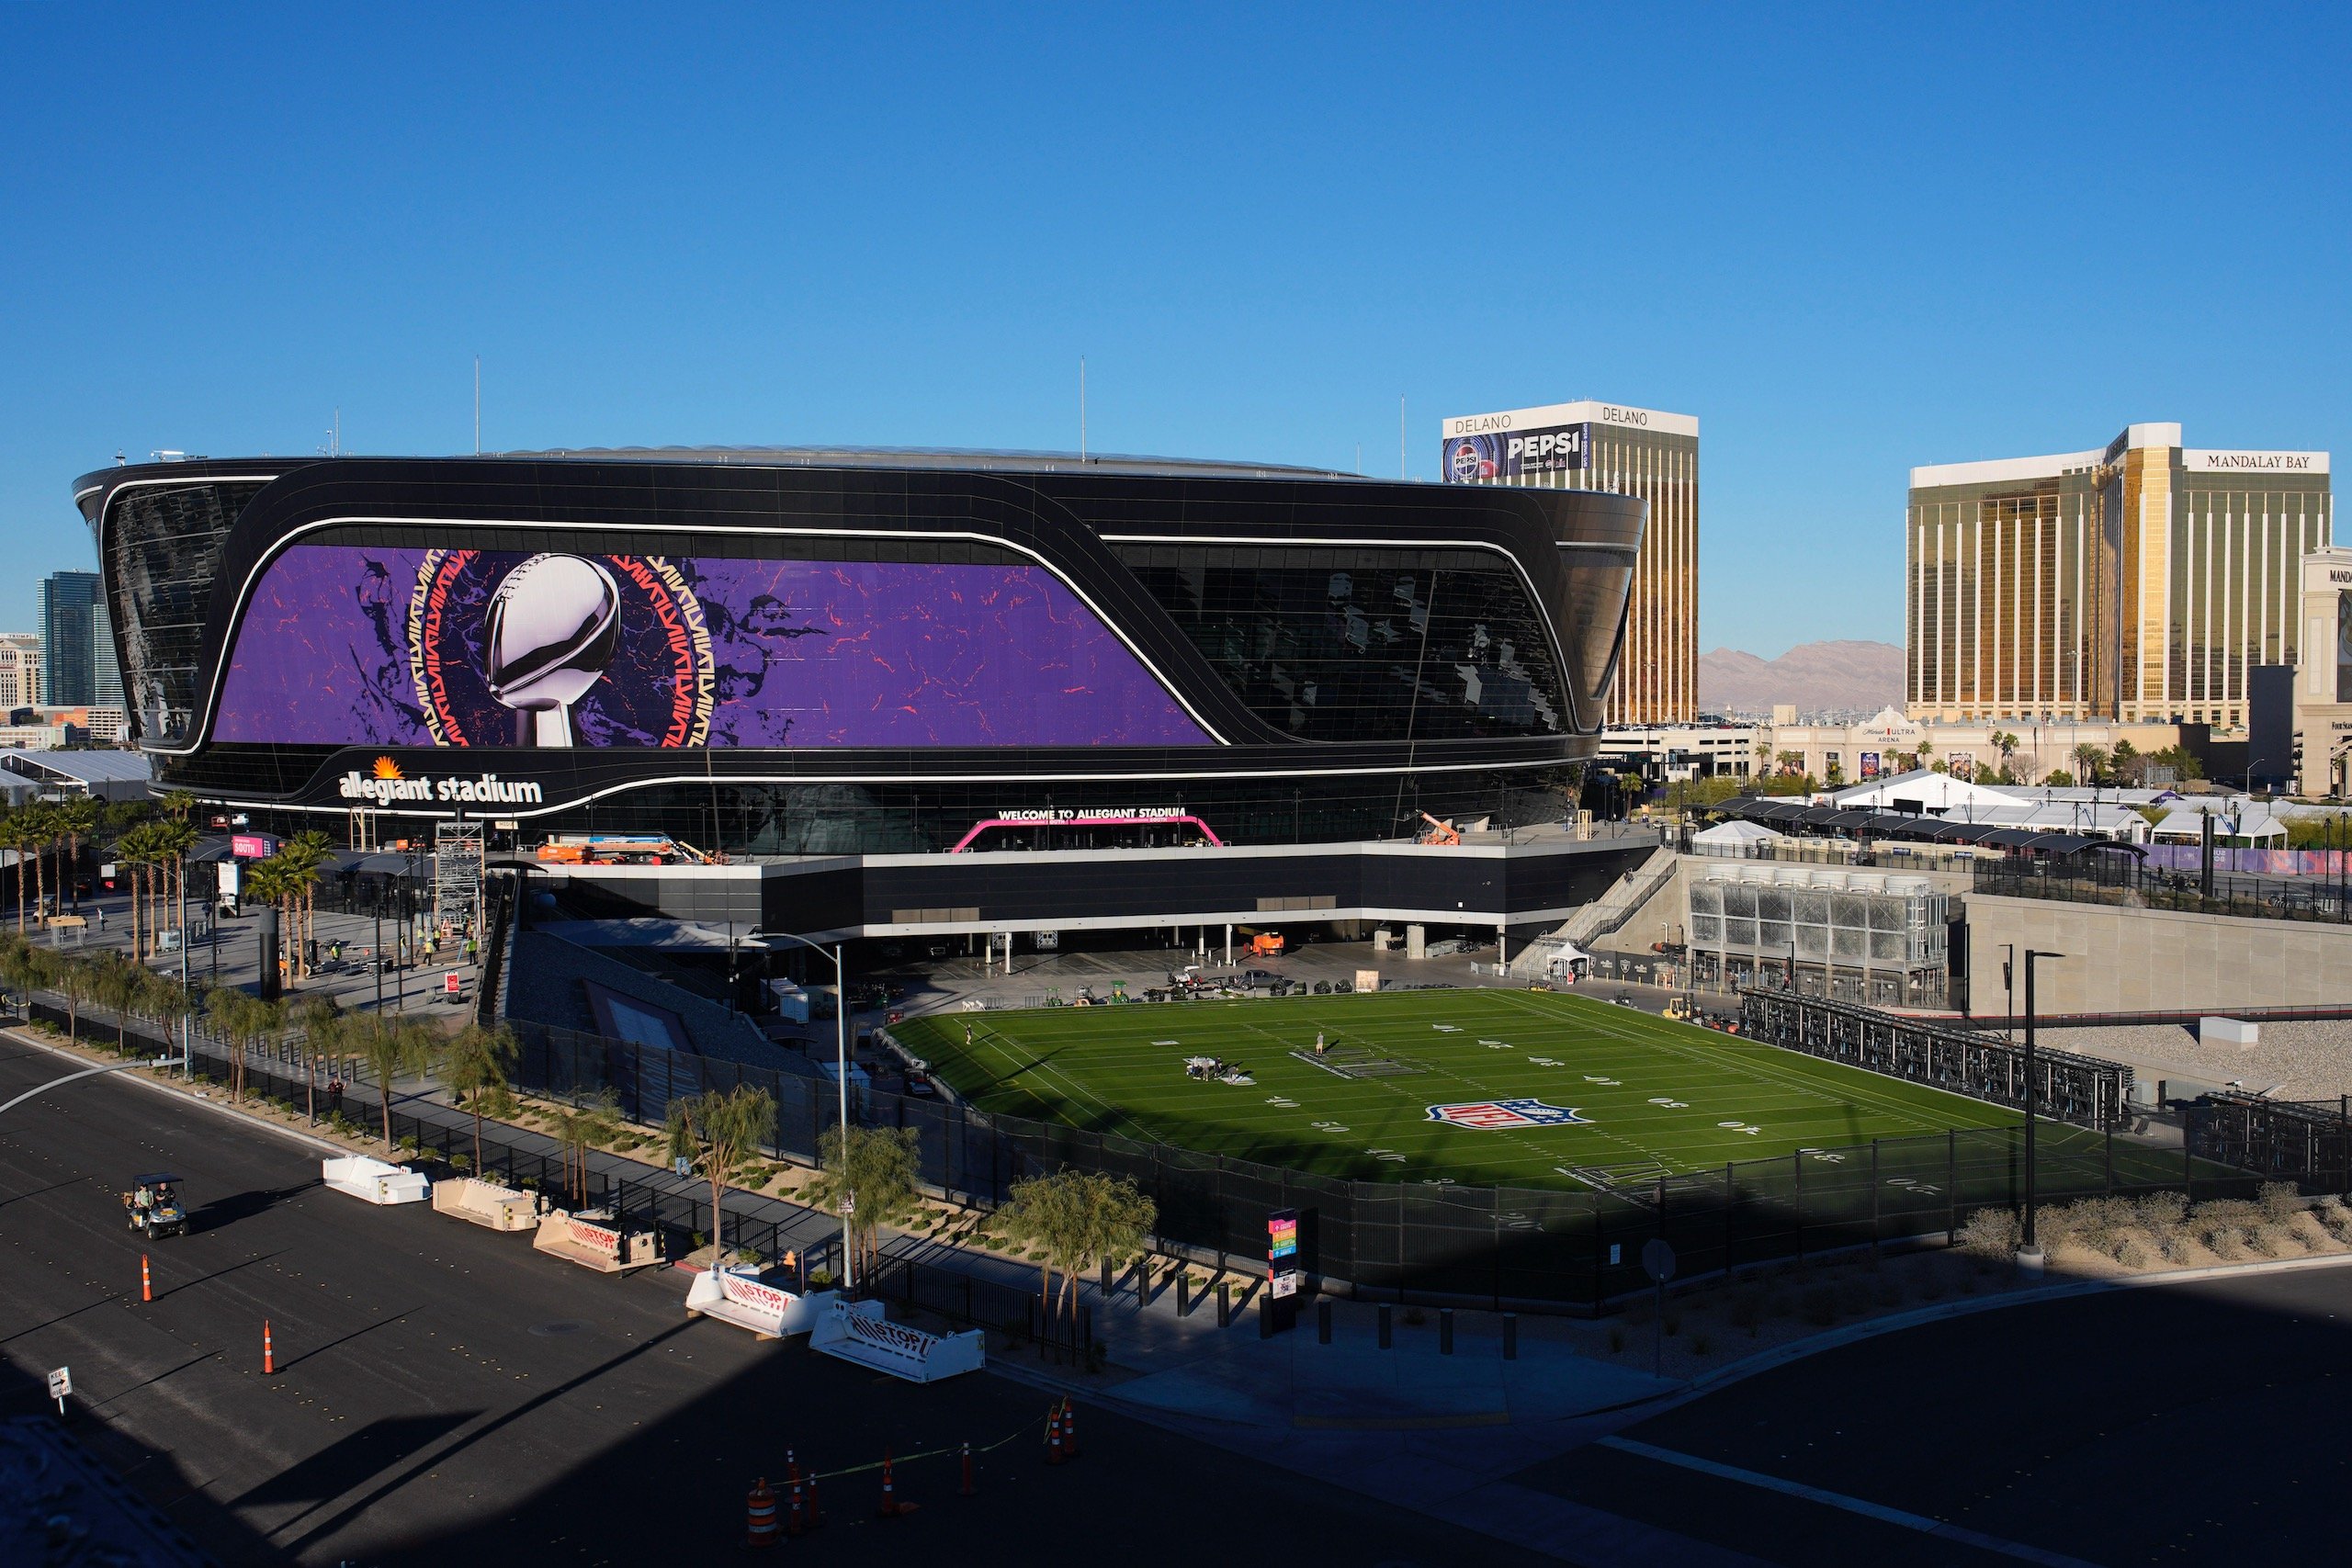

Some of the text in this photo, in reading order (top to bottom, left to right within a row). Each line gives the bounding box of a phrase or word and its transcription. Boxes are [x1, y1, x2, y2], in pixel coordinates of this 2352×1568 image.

[1455, 414, 1512, 434] DELANO
[1602, 407, 1647, 425] DELANO
[1509, 431, 1579, 459] PEPSI
[2207, 455, 2311, 468] MANDALAY BAY
[2330, 570, 2352, 582] MAND
[338, 771, 543, 807] allegiant stadium
[999, 807, 1186, 820] WELCOME TO ALLEGIANT STADIUM
[234, 842, 255, 854] SOUTH
[1442, 1104, 1528, 1127] NFL
[584, 1227, 616, 1244] STOP
[744, 1284, 782, 1303] STOP
[875, 1323, 921, 1345] STOP
[52, 1385, 71, 1395] RIGHT
